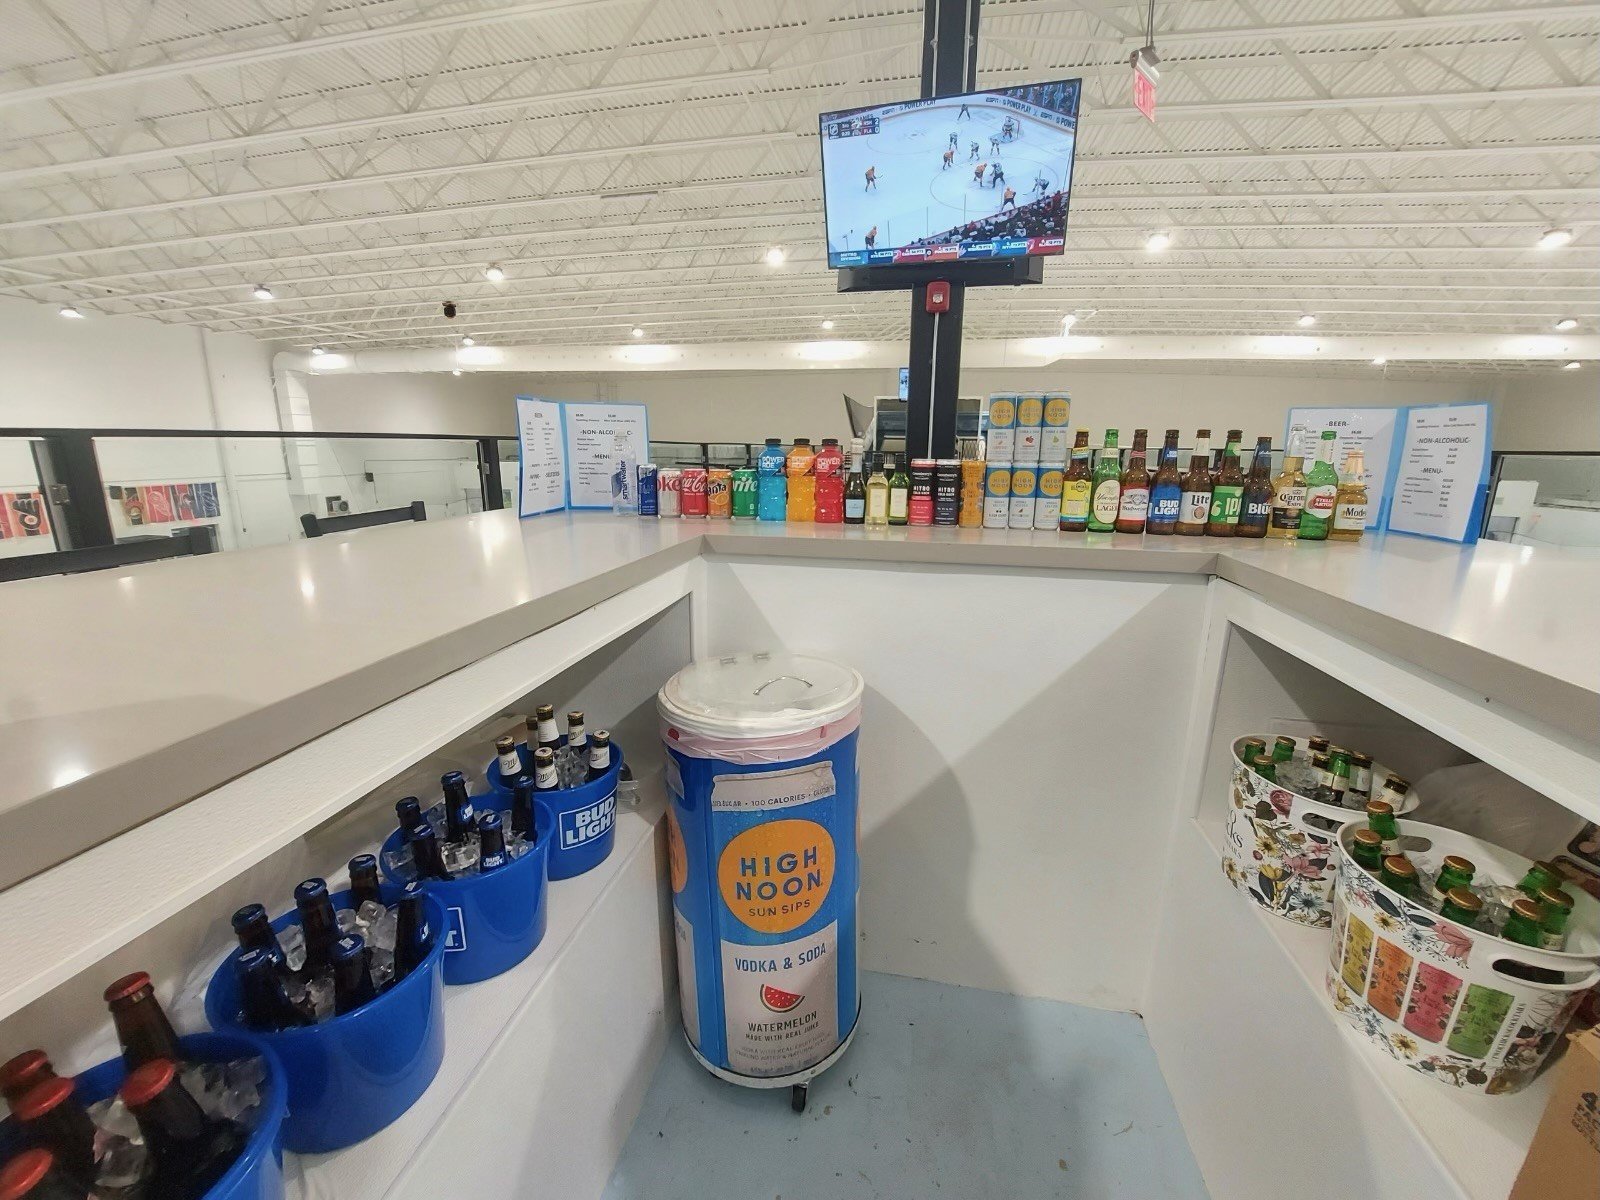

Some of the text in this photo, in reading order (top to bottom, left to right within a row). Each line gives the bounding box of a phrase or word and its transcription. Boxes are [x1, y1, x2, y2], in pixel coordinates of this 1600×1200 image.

[1006, 99, 1022, 110] POWER
[733, 476, 758, 492] rite
[1160, 500, 1179, 508] BUD
[1191, 495, 1210, 506] Lite
[768, 793, 806, 805] CALORIES
[575, 796, 615, 828] BUD
[566, 806, 617, 845] LIGHT
[741, 846, 817, 877] HIGH
[736, 869, 822, 901] NOON
[748, 899, 811, 917] SUN SIPS
[735, 942, 826, 973] VODKA & SODA
[748, 1010, 818, 1033] WATERMELON
[785, 1029, 802, 1040] REAL
